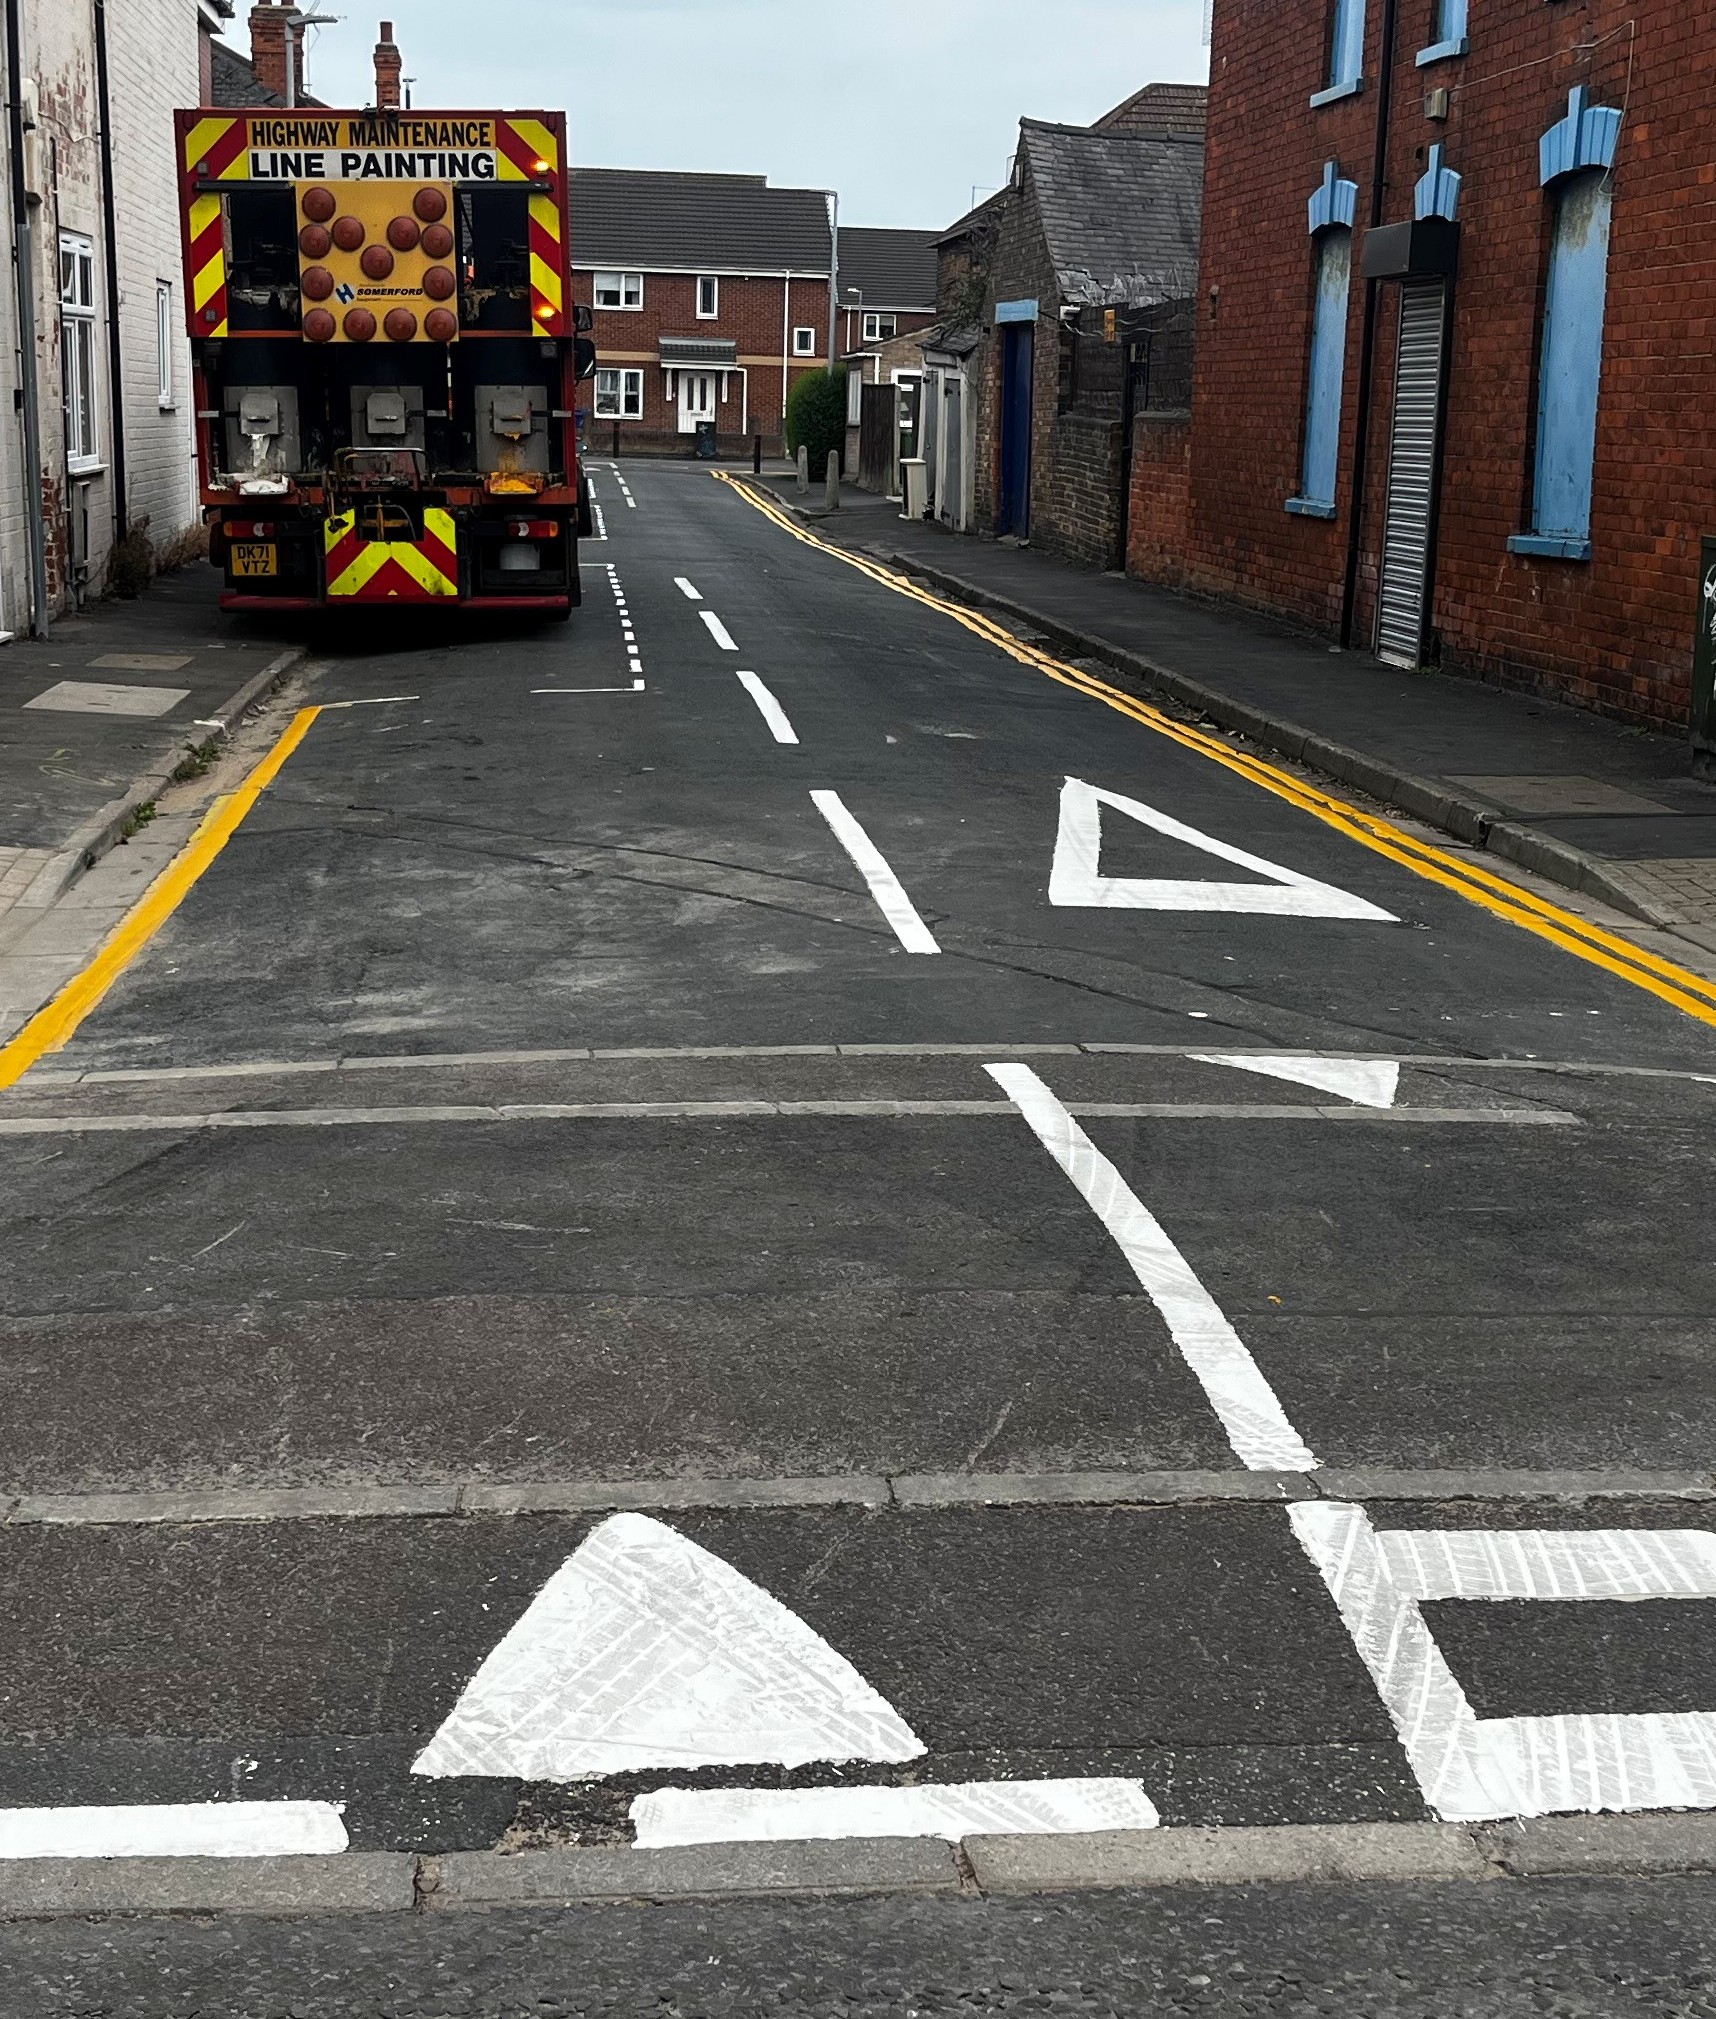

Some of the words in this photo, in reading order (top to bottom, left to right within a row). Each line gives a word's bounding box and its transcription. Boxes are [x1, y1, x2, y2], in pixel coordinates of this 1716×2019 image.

[252, 121, 340, 146] HIGHWAY
[349, 121, 491, 147] MAINTENANCE
[251, 152, 325, 178] LINE
[341, 152, 494, 178] PAINTING
[357, 288, 424, 296] SOMERFORD
[237, 545, 270, 559] DK71
[242, 560, 271, 573] VTZ
